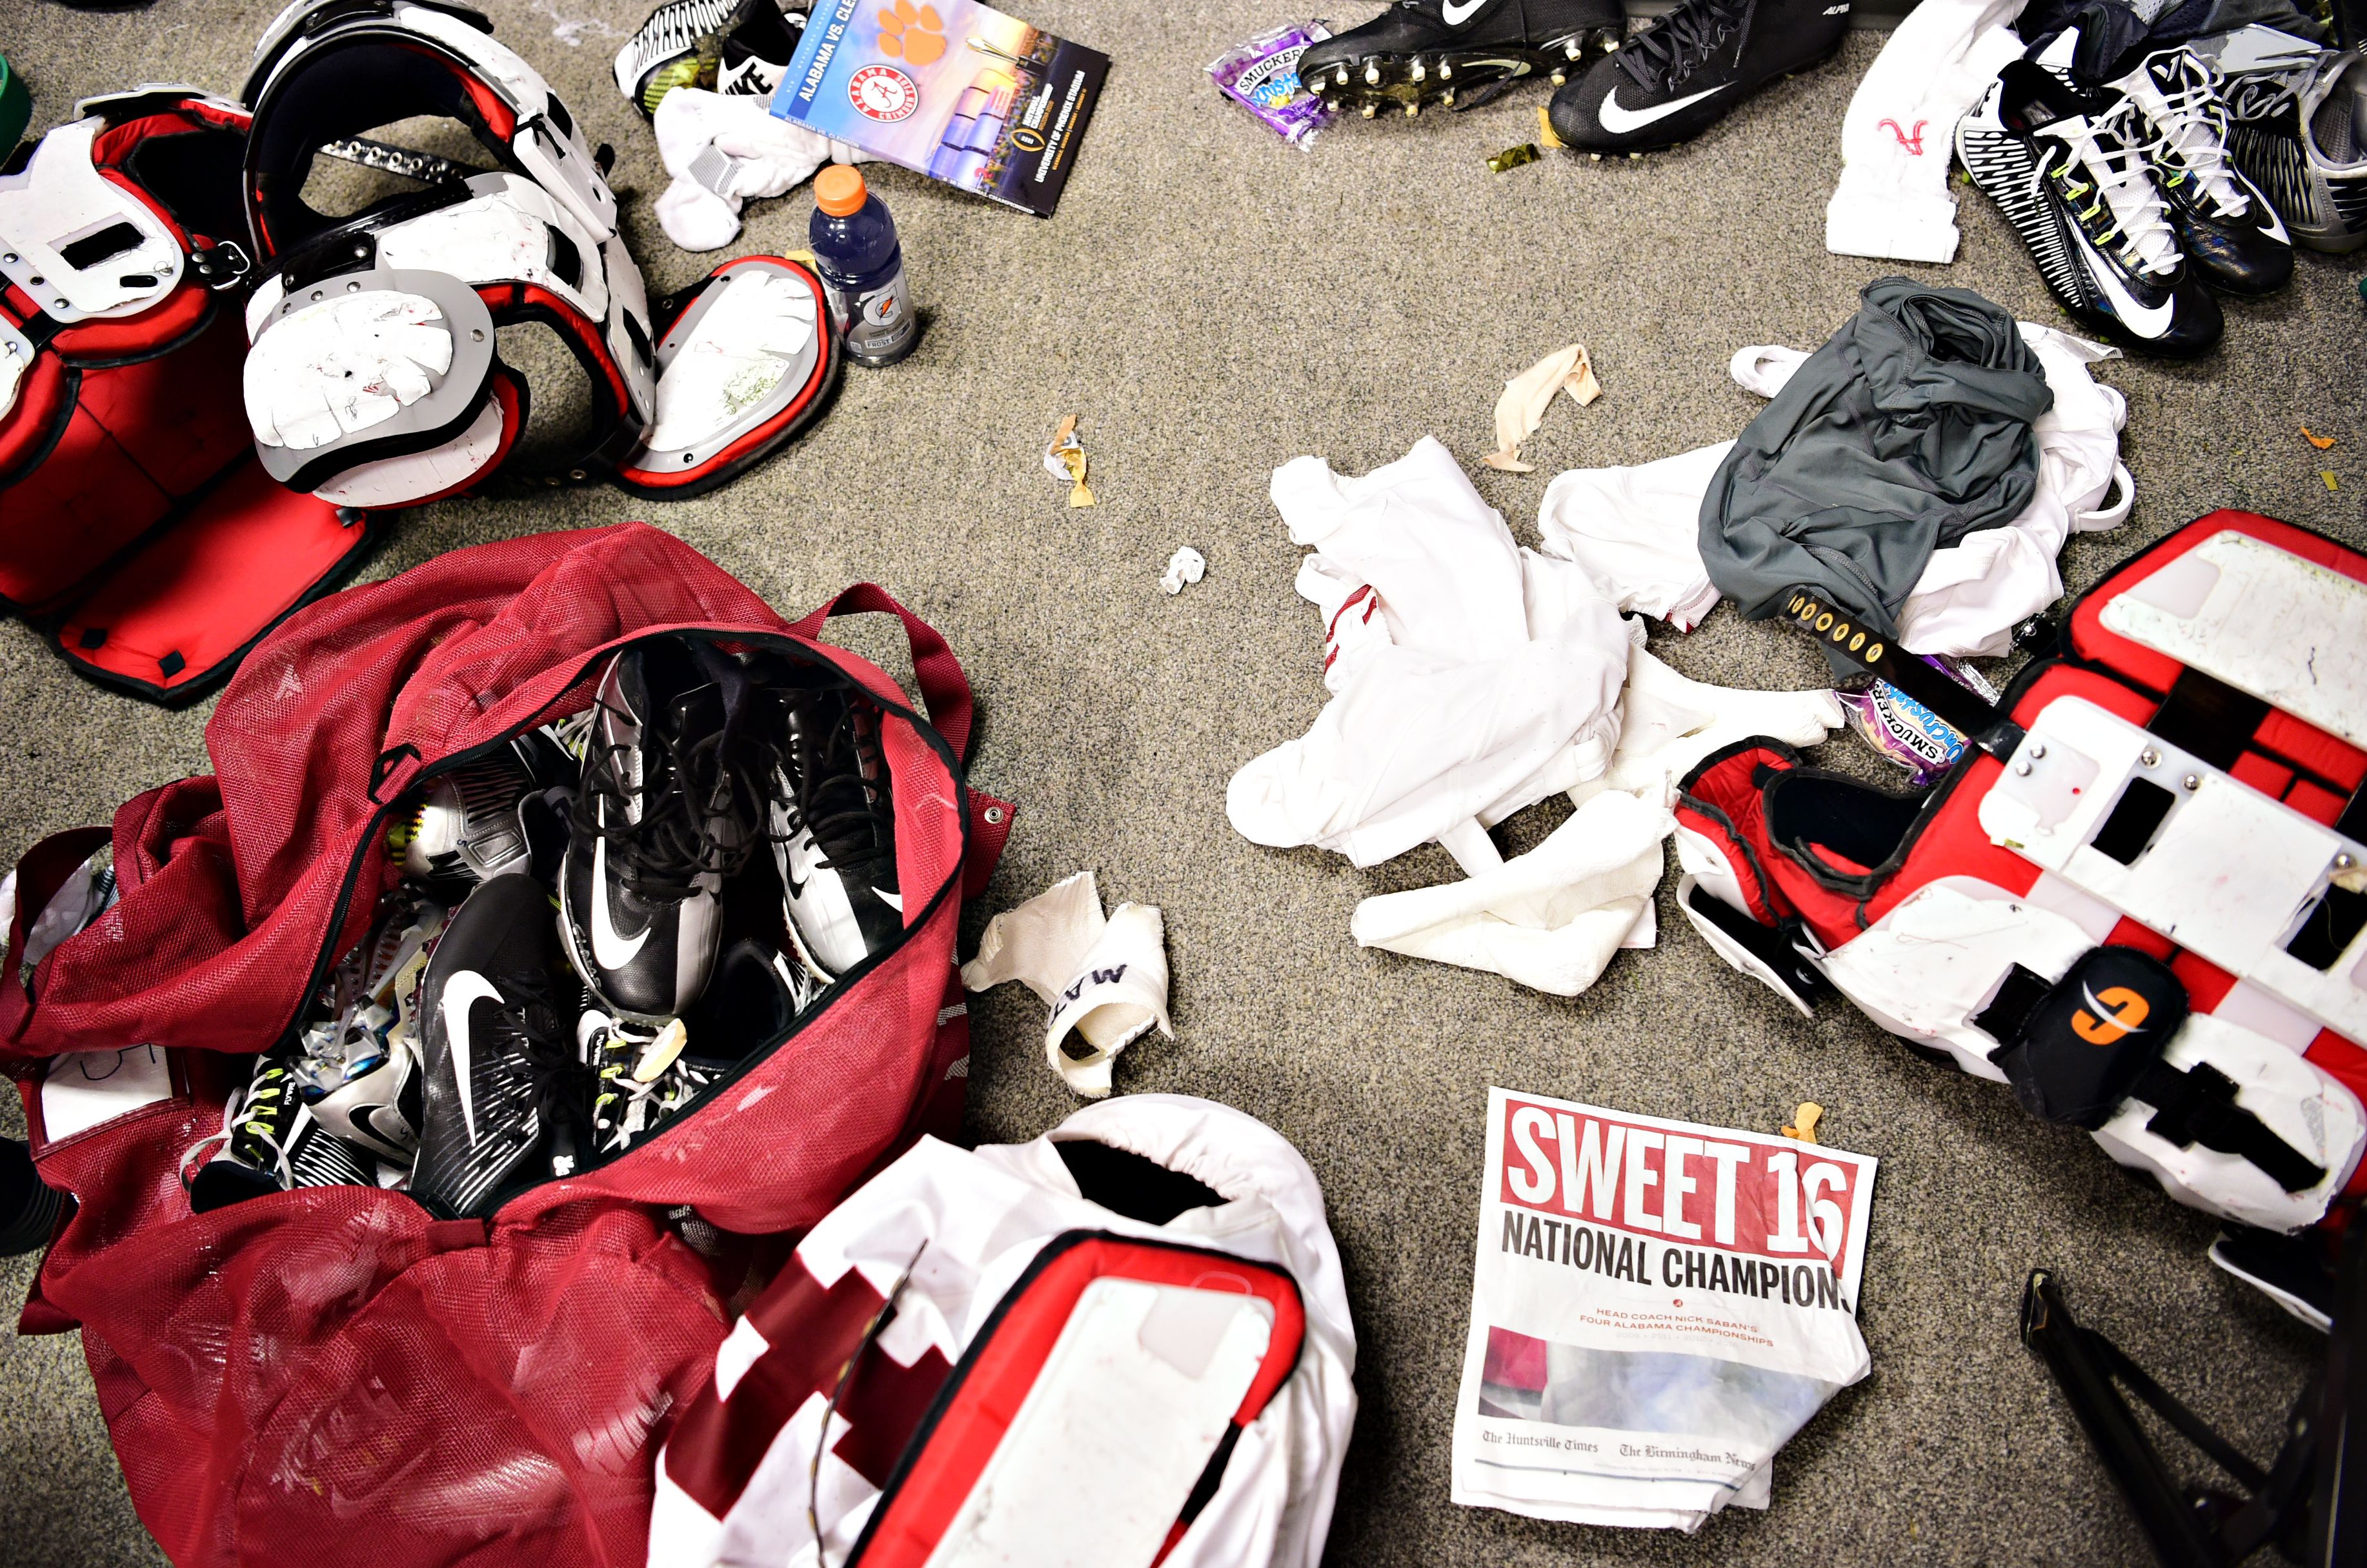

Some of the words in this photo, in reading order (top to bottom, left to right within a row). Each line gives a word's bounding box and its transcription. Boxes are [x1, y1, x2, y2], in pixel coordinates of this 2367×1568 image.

[725, 61, 773, 95] IKE
[798, 42, 836, 102] ALABAMA
[826, 23, 845, 42] VS.
[1240, 47, 1304, 91] SMUCKER'
[851, 68, 888, 114] ALABAMA
[894, 74, 915, 96] TIDE
[1066, 70, 1085, 102] STADIUM
[878, 96, 915, 121] CRIMSON
[1023, 95, 1040, 126] NATIONAL
[1030, 83, 1053, 129] CHAMPIONSHIP
[1054, 100, 1074, 132] PHOENIX
[785, 116, 816, 132] ALABAMA
[1050, 129, 1062, 141] OF
[1034, 138, 1058, 183] UNIVERSITY
[867, 340, 890, 348] FROST
[1870, 683, 1939, 759] SMUCKER'
[1506, 1106, 1750, 1245] SWEET
[1766, 1150, 1847, 1263] 16
[1502, 1210, 1652, 1286] NATIONAL
[1662, 1248, 1851, 1314] CHAMPION
[1580, 1314, 1611, 1327] FOUR
[1613, 1322, 1673, 1331] ALABAMA
[1676, 1325, 1774, 1347] CHAMPIONSHIPS
[1596, 1307, 1628, 1320] HEAD
[1631, 1312, 1673, 1322] COACH
[1675, 1315, 1704, 1323] NICK
[1706, 1318, 1758, 1333] SABAN'S
[1482, 1429, 1503, 1444] The
[1505, 1432, 1562, 1451] Huntsville
[1564, 1439, 1599, 1453] Times
[1619, 1443, 1642, 1458] The
[1645, 1445, 1722, 1463] Birmingham
